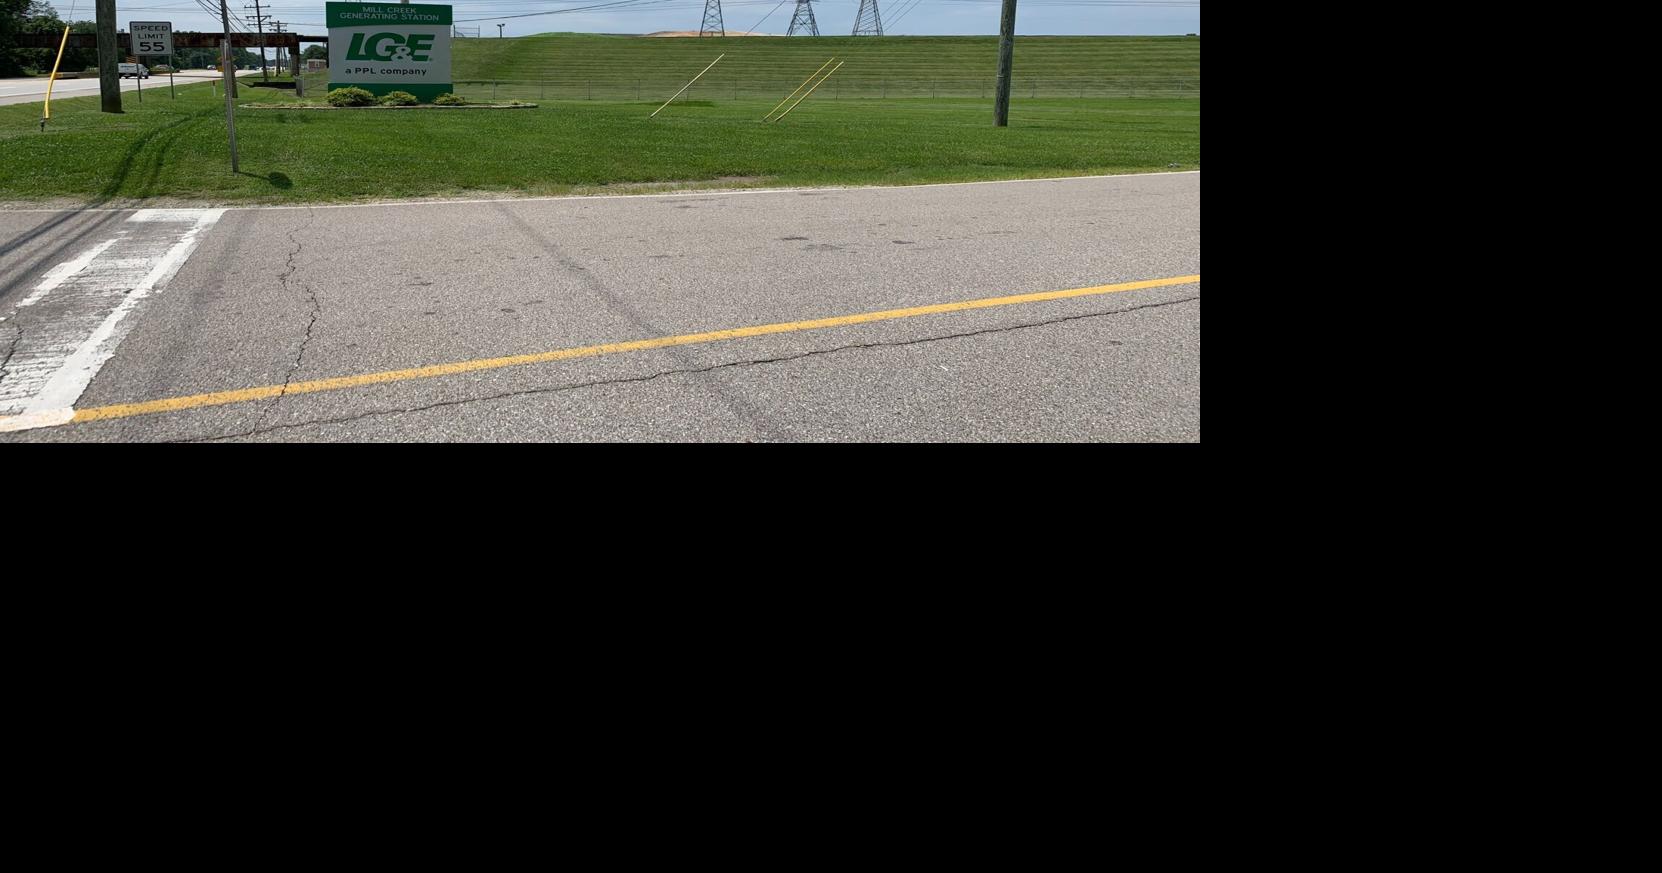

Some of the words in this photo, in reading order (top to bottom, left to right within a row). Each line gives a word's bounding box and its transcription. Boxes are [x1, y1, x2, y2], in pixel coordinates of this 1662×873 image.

[401, 13, 440, 21] STATION
[140, 41, 165, 52] 55
[345, 32, 436, 62] LG&E
[354, 67, 377, 75] PPL
[380, 67, 427, 76] company
